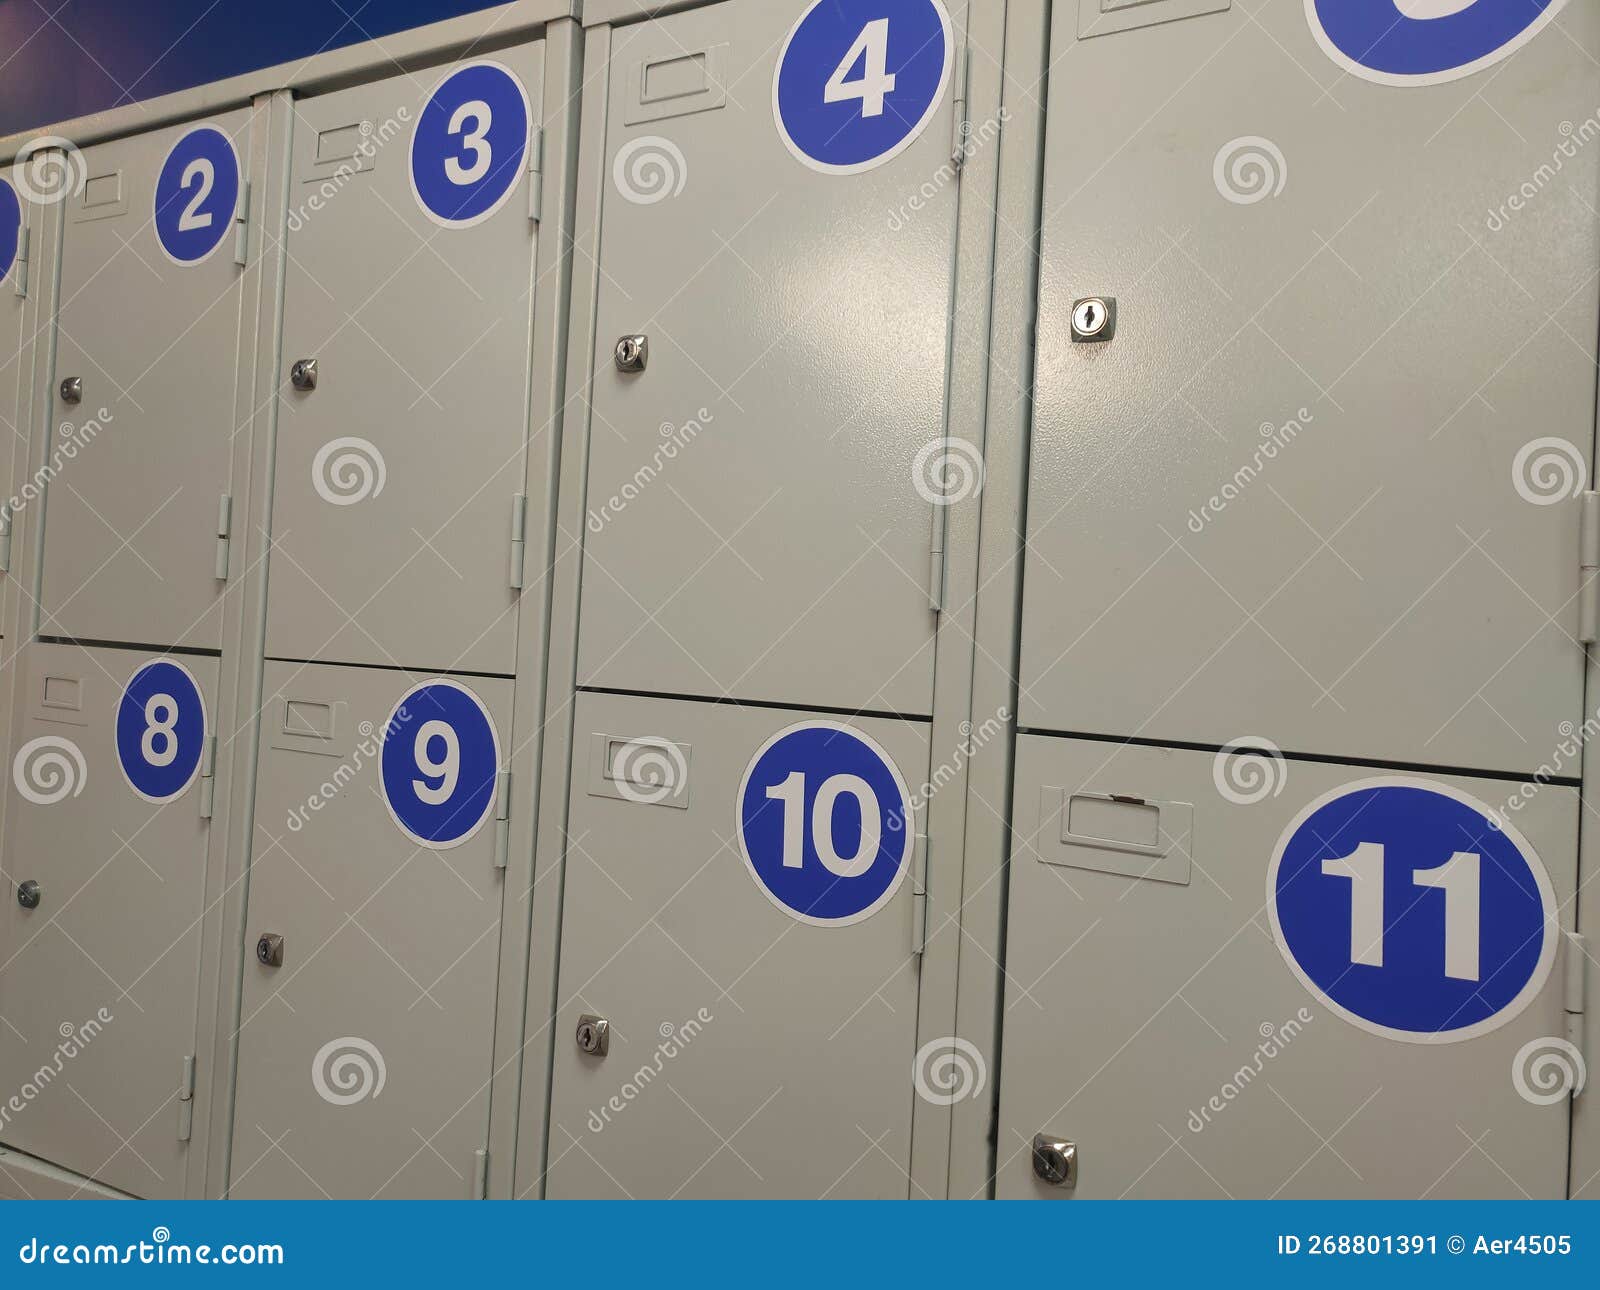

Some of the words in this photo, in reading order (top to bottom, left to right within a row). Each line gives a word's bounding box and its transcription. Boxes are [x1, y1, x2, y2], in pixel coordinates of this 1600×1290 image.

[823, 16, 896, 118] 4
[444, 99, 493, 186] 3
[176, 157, 214, 233] 2
[141, 692, 179, 768] 8
[412, 719, 460, 806] 9
[765, 771, 882, 878] 10
[1320, 841, 1481, 983] 11
